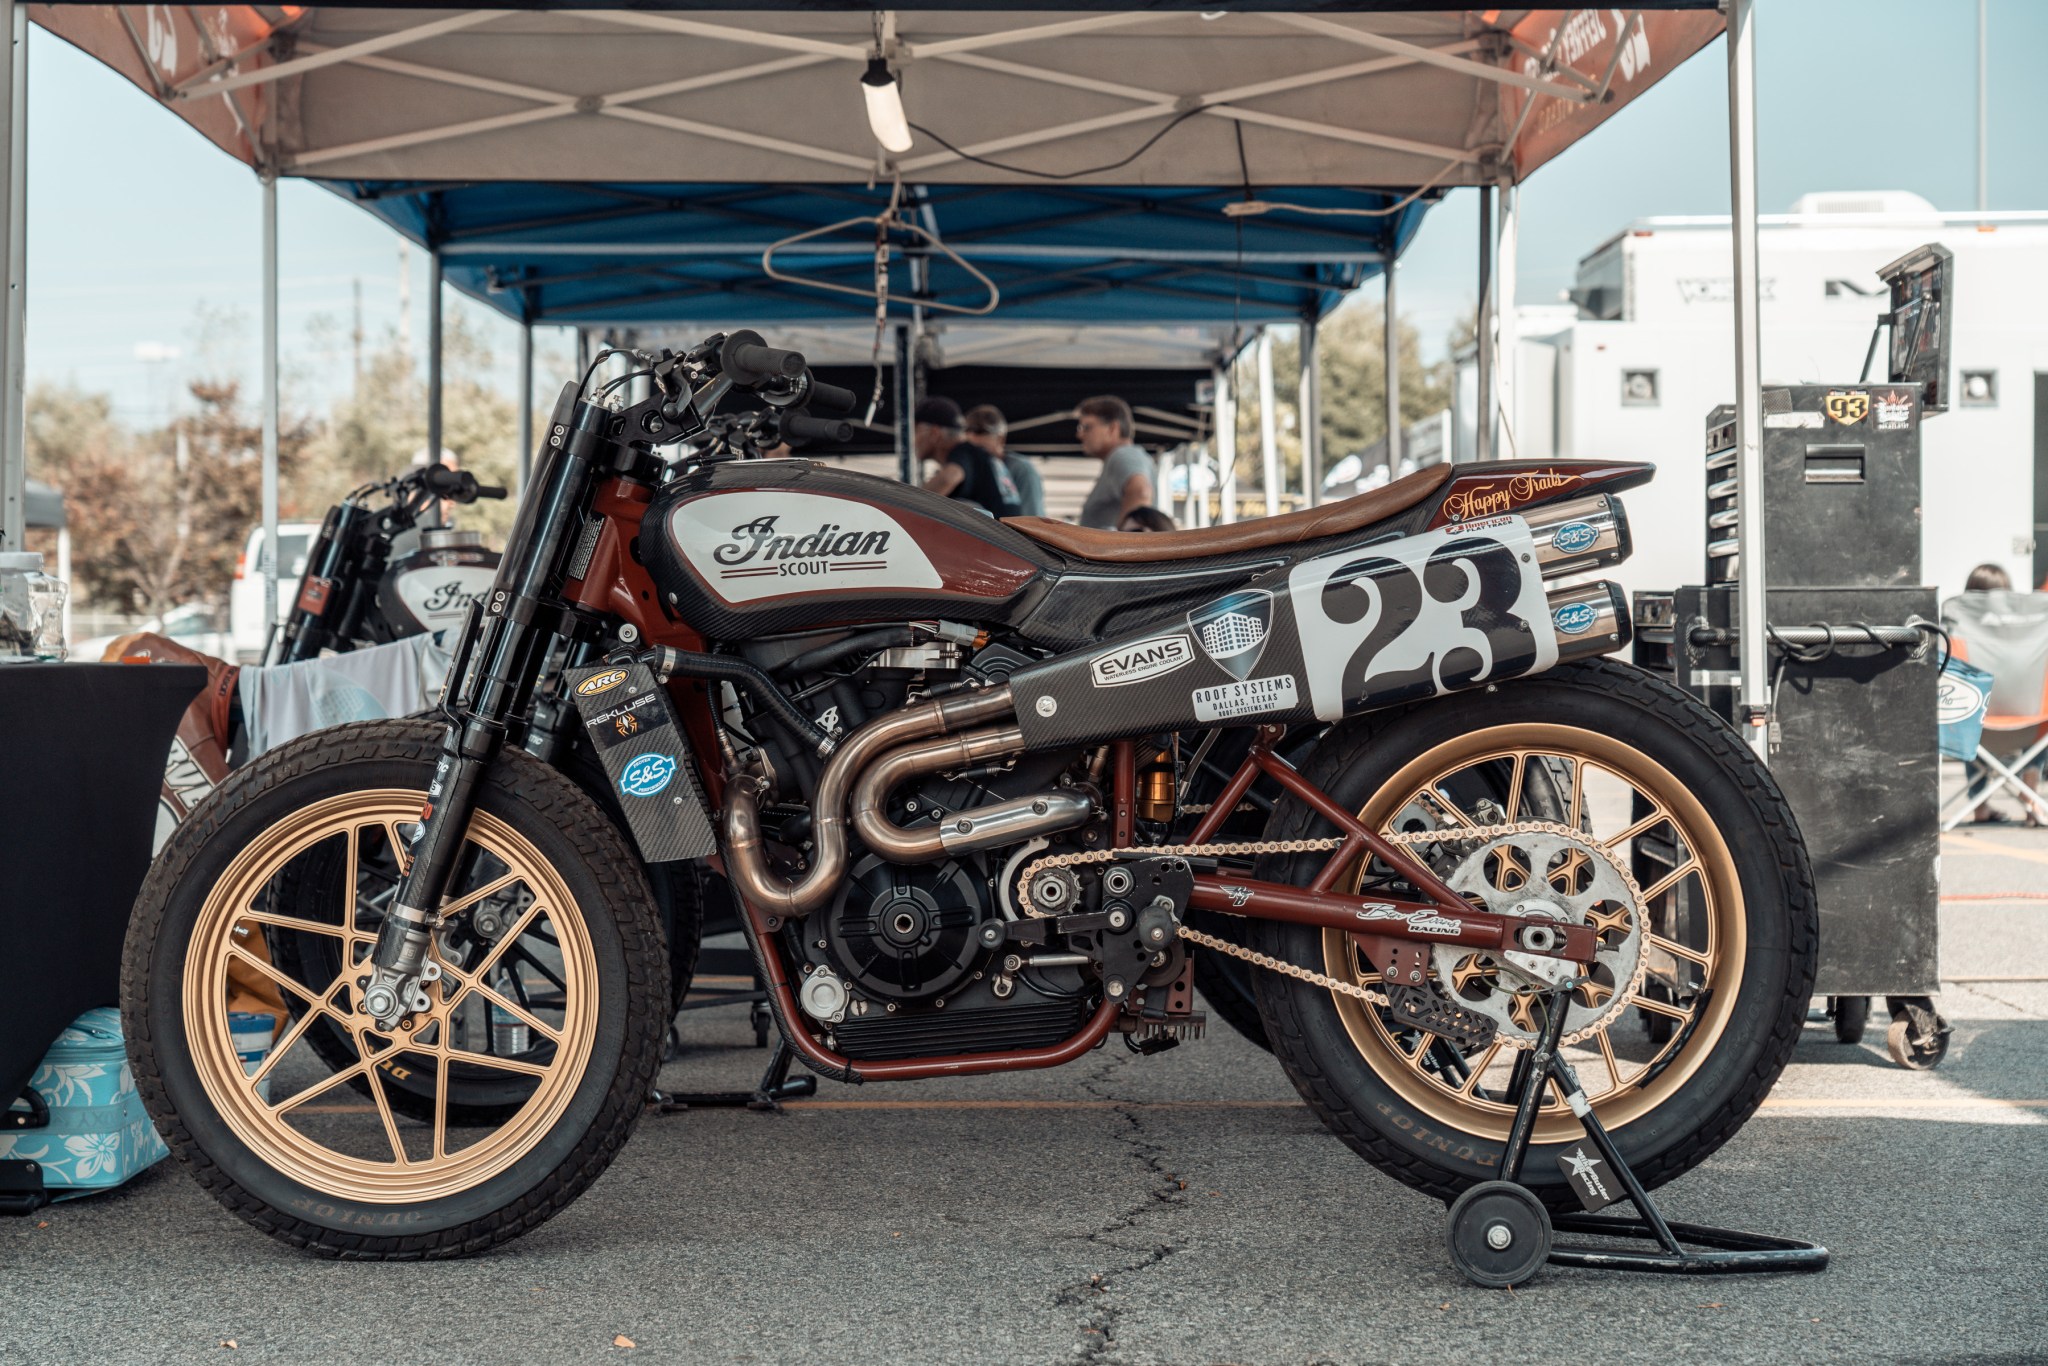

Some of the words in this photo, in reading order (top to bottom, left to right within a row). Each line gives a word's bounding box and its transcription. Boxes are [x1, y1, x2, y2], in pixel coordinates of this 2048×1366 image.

[1830, 397, 1866, 419] 93
[1443, 483, 1510, 522] Happy
[1488, 520, 1513, 529] TRACK
[1560, 527, 1592, 547] S&S
[713, 515, 891, 566] Indian
[779, 560, 829, 577] SCOUT
[424, 580, 492, 612] Ind
[1321, 537, 1537, 717] 23
[1559, 608, 1591, 627] S&S
[1099, 641, 1183, 675] EVANS
[1104, 669, 1137, 681] WATERLESS
[1137, 662, 1158, 672] ENGINE
[1159, 655, 1185, 666] COOLANT
[581, 670, 624, 694] ARC
[1196, 687, 1227, 703] ROOF
[1234, 677, 1292, 697] SYSTEMS
[585, 693, 657, 728] REKLUSE
[1212, 698, 1249, 711] DALLAS,
[1251, 693, 1278, 704] TEXAS
[1218, 703, 1275, 717] ROOF-SYSTEMS.NET
[629, 759, 665, 789] S&S
[1410, 925, 1460, 935] RACING
[1376, 1103, 1500, 1167] DUNLOP
[1590, 1173, 1610, 1201] Butler
